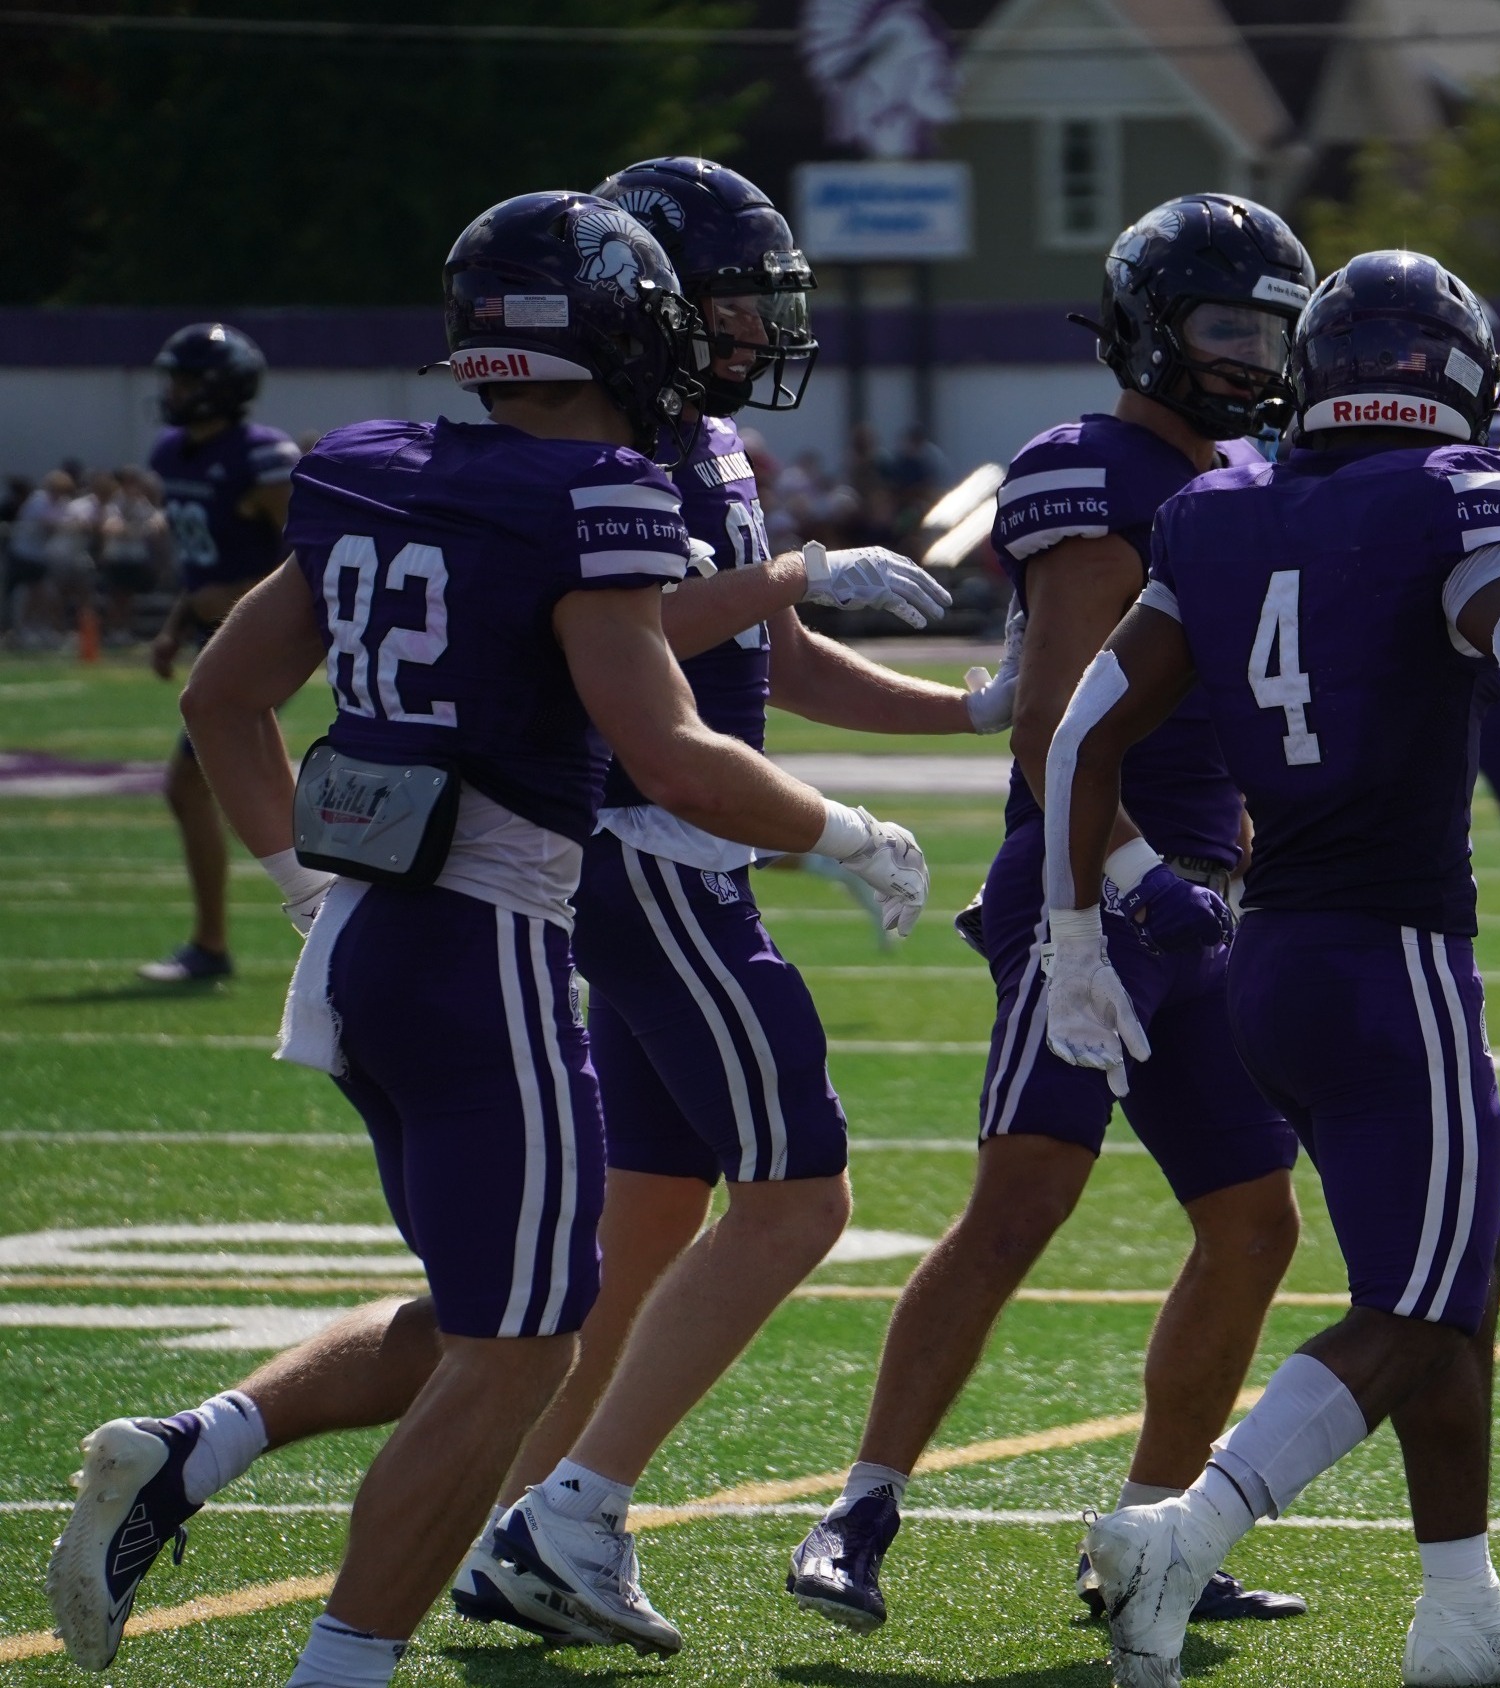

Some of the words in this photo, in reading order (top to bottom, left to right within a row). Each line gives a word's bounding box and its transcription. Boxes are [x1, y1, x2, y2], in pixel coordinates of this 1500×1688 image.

[450, 354, 531, 382] Riddell
[1333, 400, 1437, 425] Riddell
[322, 533, 458, 728] 82
[1247, 569, 1321, 766] 4
